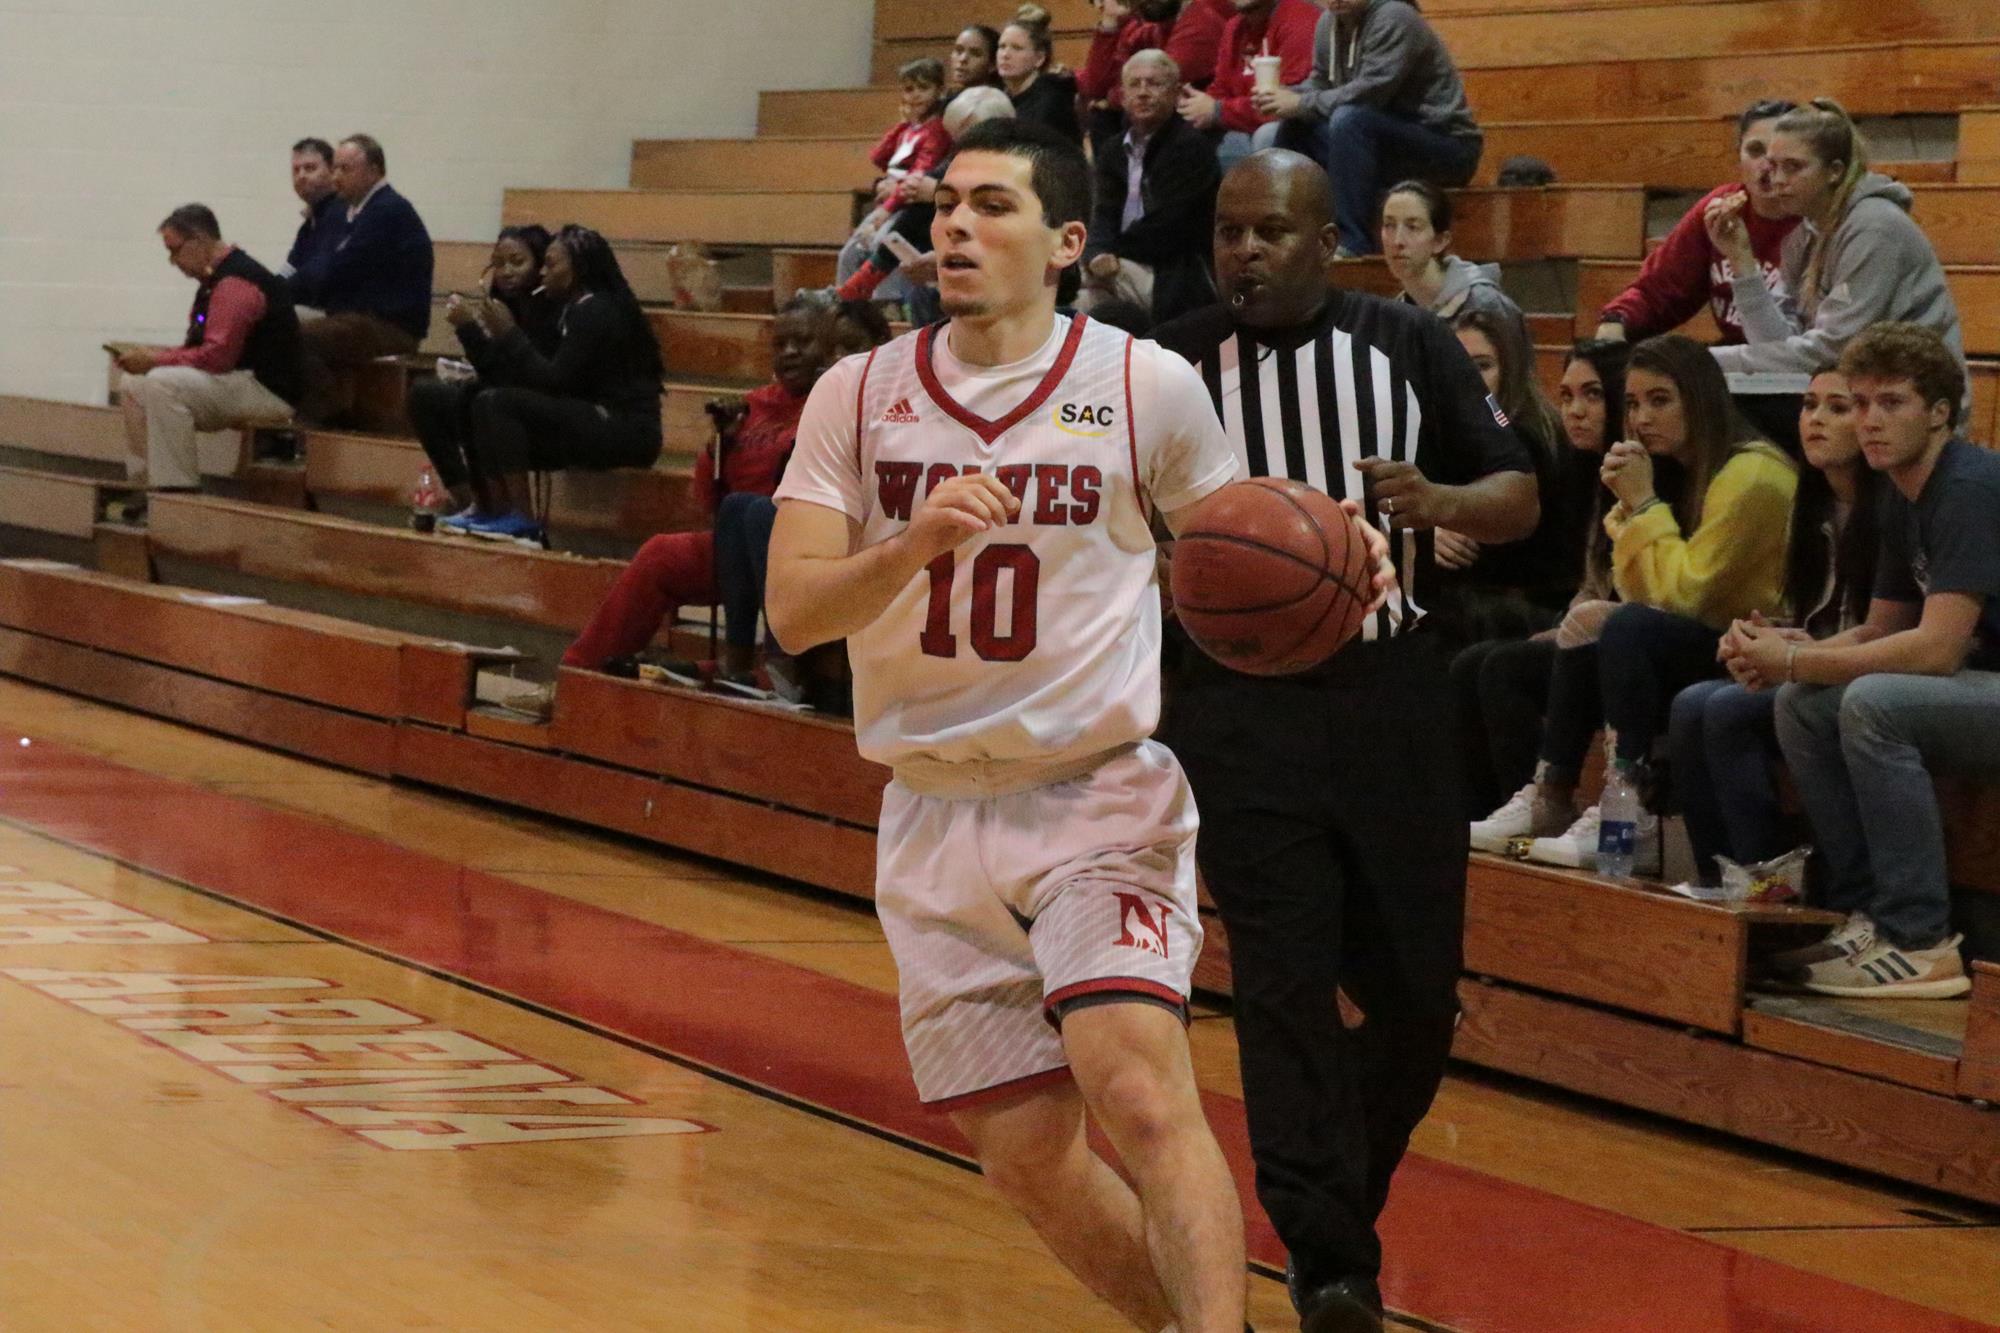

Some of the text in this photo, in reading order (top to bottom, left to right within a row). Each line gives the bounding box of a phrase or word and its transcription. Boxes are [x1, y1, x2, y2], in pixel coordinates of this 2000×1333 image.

[881, 413, 920, 424] adidas
[1060, 403, 1114, 427] SAC
[874, 460, 1102, 526] WVES
[919, 543, 1040, 662] 10
[0, 967, 722, 1151] ARENA
